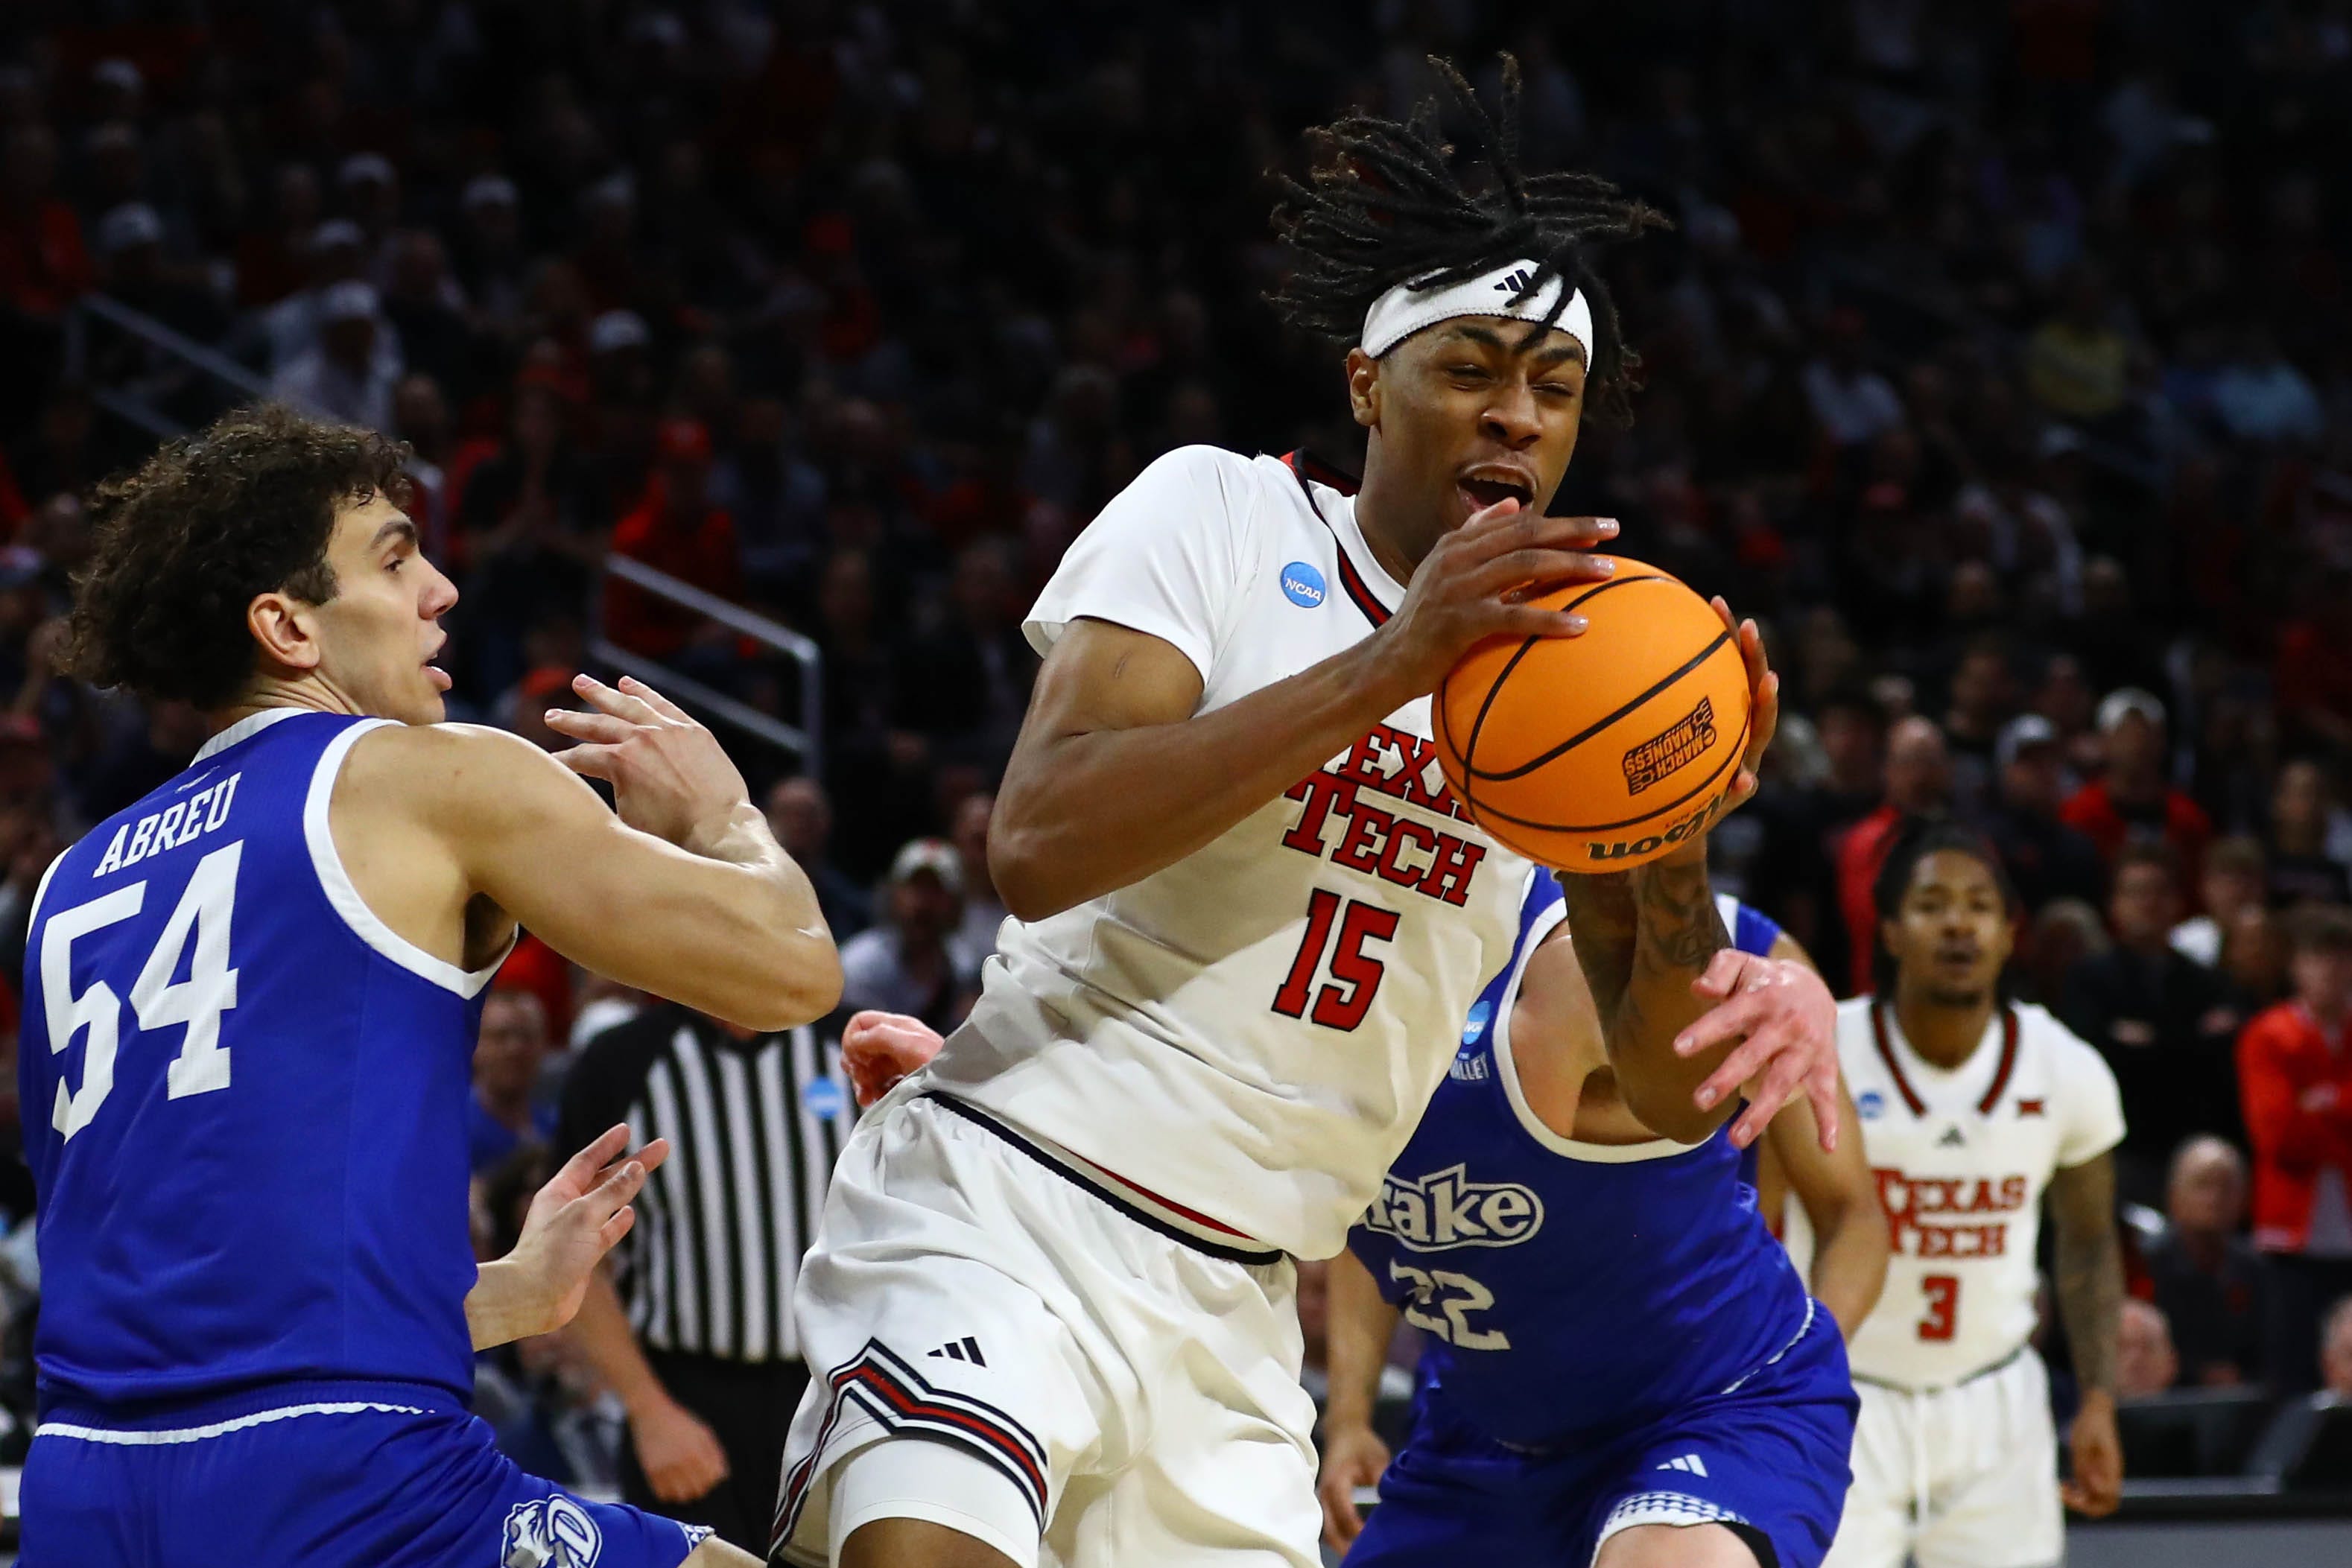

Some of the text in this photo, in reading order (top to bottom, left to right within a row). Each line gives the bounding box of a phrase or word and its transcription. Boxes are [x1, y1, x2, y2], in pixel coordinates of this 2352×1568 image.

[1285, 577, 1322, 601] NCAA
[1624, 720, 1694, 776] MADNESS
[1655, 732, 1705, 779] MARCH
[92, 772, 241, 878] ABREU
[1281, 769, 1488, 907] TECH
[40, 839, 244, 1146] 54
[1271, 887, 1401, 1032] 15
[1366, 1178, 1532, 1244] rake
[1870, 1168, 2026, 1216] TEXAS
[1389, 1257, 1512, 1351] 22
[1918, 1275, 1958, 1341] 3
